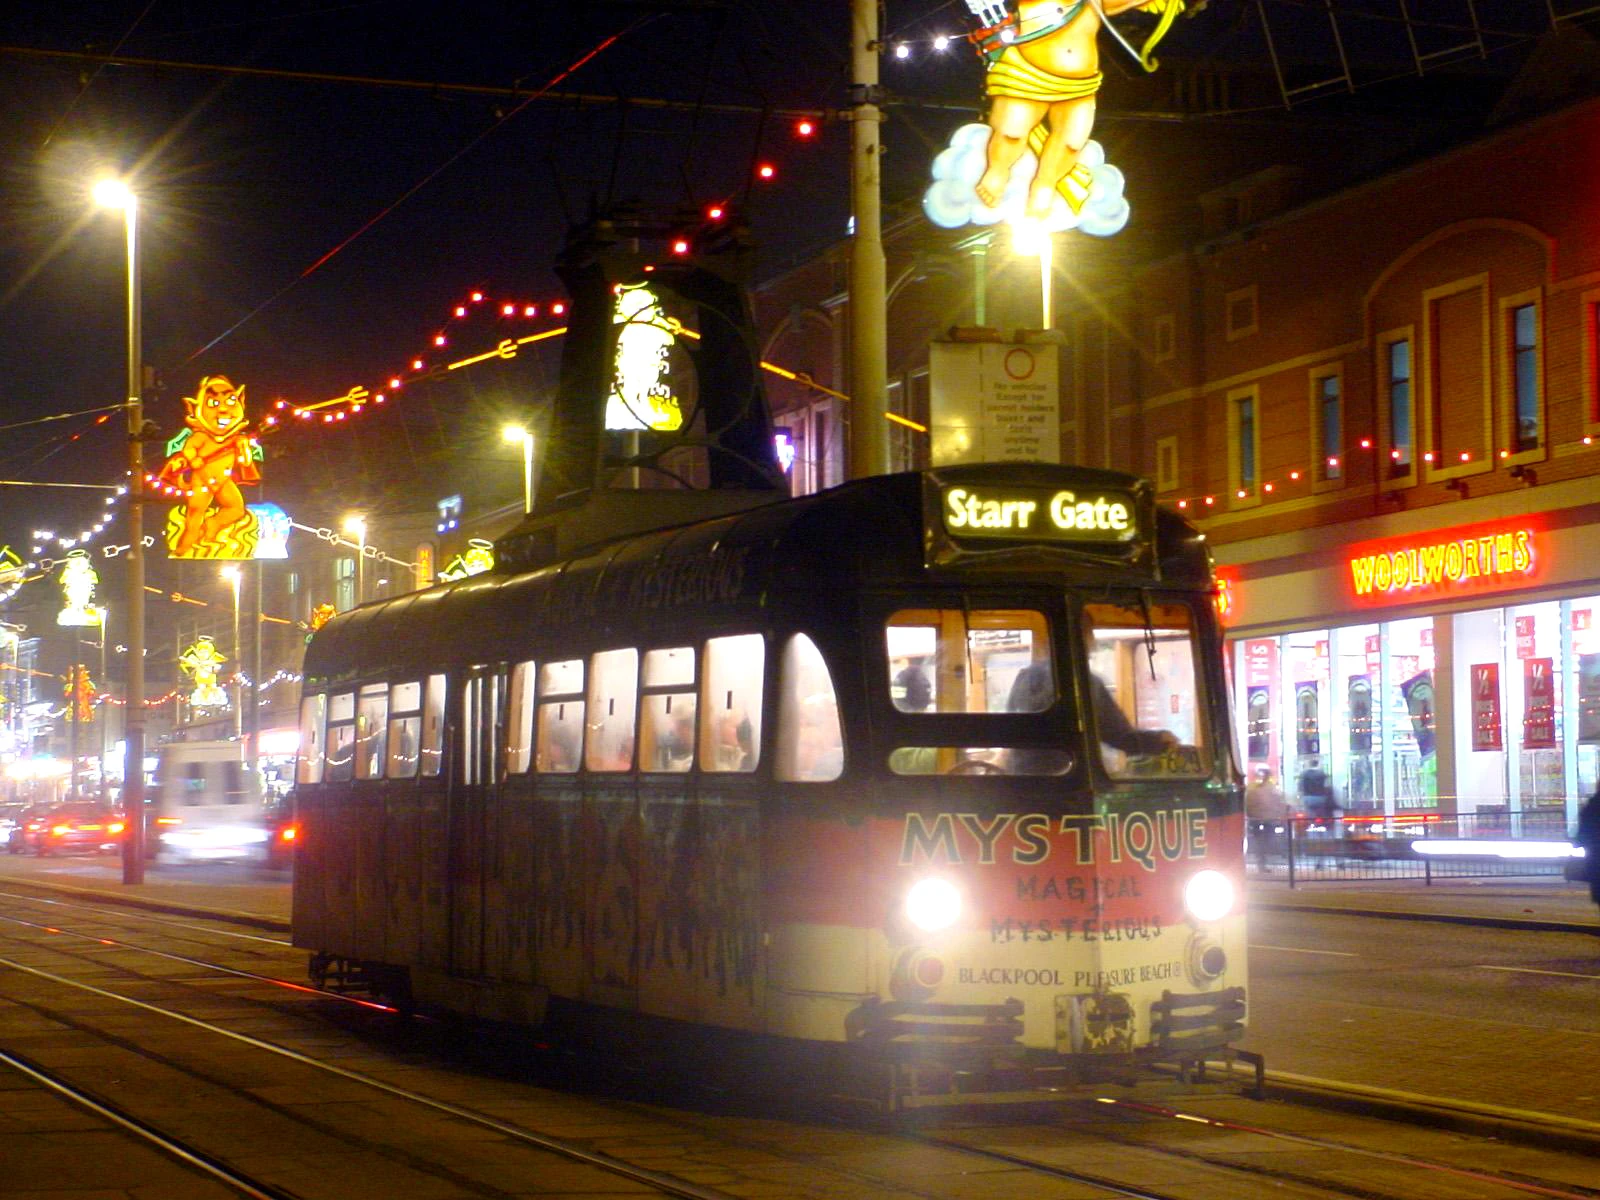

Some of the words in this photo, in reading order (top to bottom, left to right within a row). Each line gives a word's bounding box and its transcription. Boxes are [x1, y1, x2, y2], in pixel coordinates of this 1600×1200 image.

[948, 489, 1036, 528] Starr
[1051, 491, 1128, 529] Gate
[1351, 531, 1530, 595] WOOLWORTHS
[898, 807, 1209, 872] MYSTIQUE
[1016, 874, 1142, 904] MAGICAL
[959, 967, 1064, 986] BLACKPOOL
[1074, 967, 1136, 988] PLEASURE
